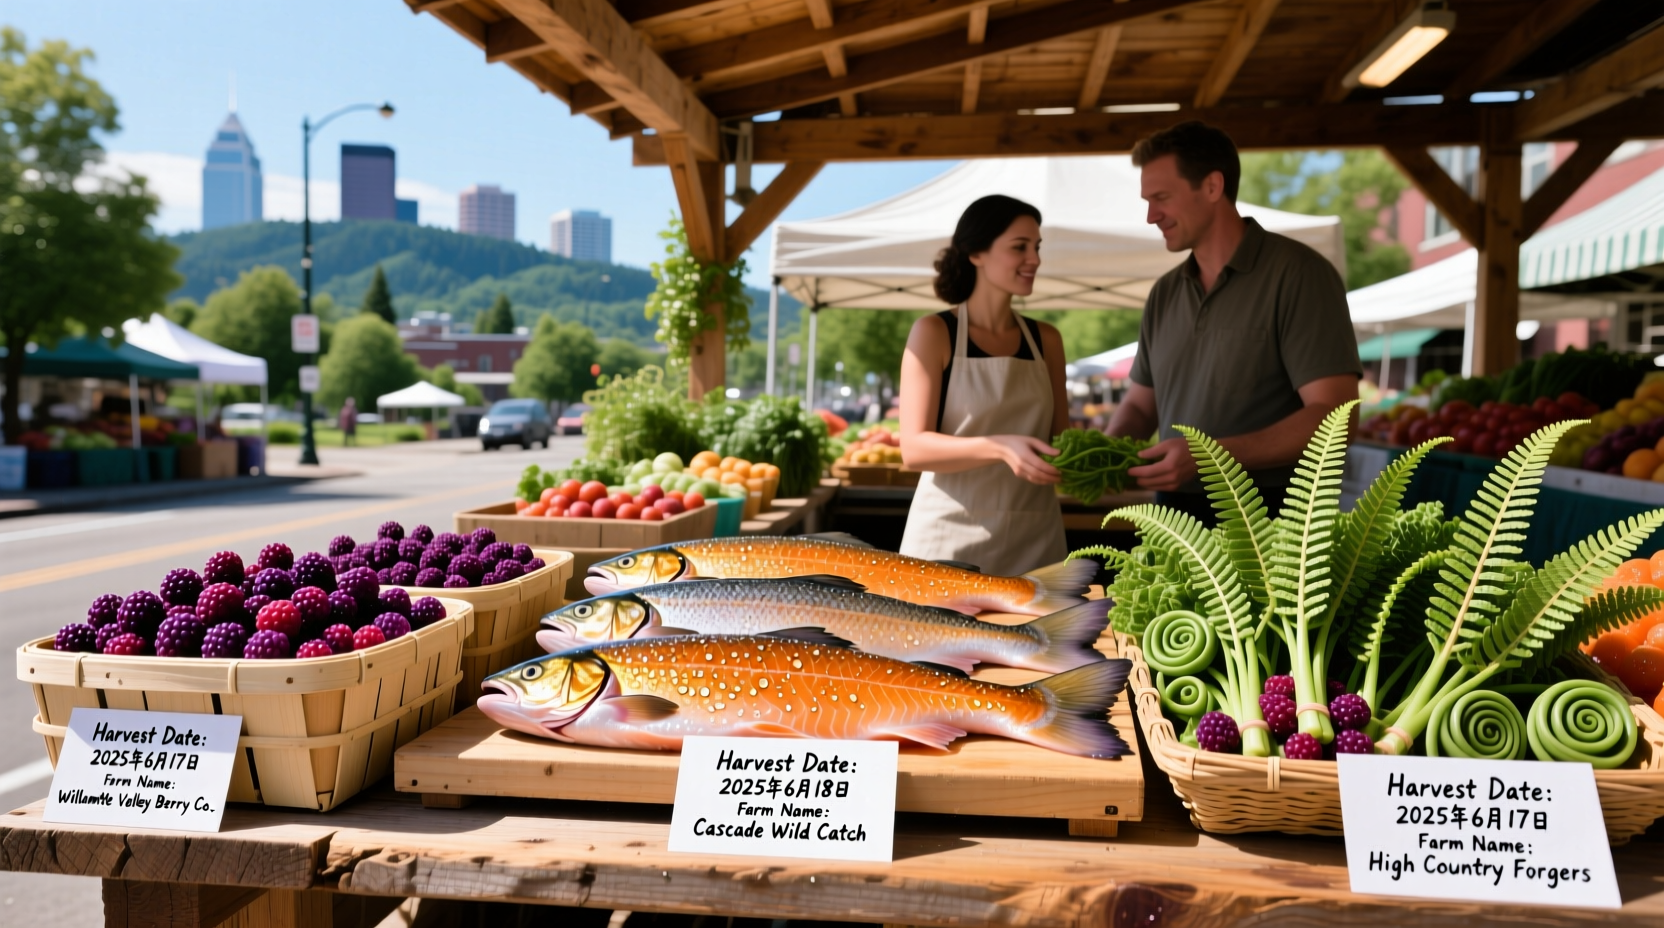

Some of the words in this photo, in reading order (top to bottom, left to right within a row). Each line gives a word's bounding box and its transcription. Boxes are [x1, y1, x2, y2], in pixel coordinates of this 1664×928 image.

[92, 722, 158, 743] Harvest
[161, 726, 207, 746] Date:
[89, 748, 199, 771] 2025年6月17日
[716, 750, 795, 771] Harvest
[802, 753, 857, 773] Date:
[136, 776, 176, 789] Name:
[718, 776, 849, 799] 2025年6月18日
[1387, 773, 1477, 799] Harvest
[1488, 777, 1552, 801] Date:
[154, 795, 191, 815] Berry
[737, 802, 774, 816] Farm
[780, 803, 830, 817] Name:
[1396, 804, 1547, 830] 2025年6月17日
[693, 818, 764, 838] Cascade
[771, 822, 812, 839] Wild
[816, 823, 866, 841] Catch
[1418, 833, 1464, 850] Farm
[1472, 835, 1532, 854] Name:
[1369, 852, 1415, 880] High
[1423, 855, 1504, 885] Country
[1514, 859, 1591, 888] Forgers
